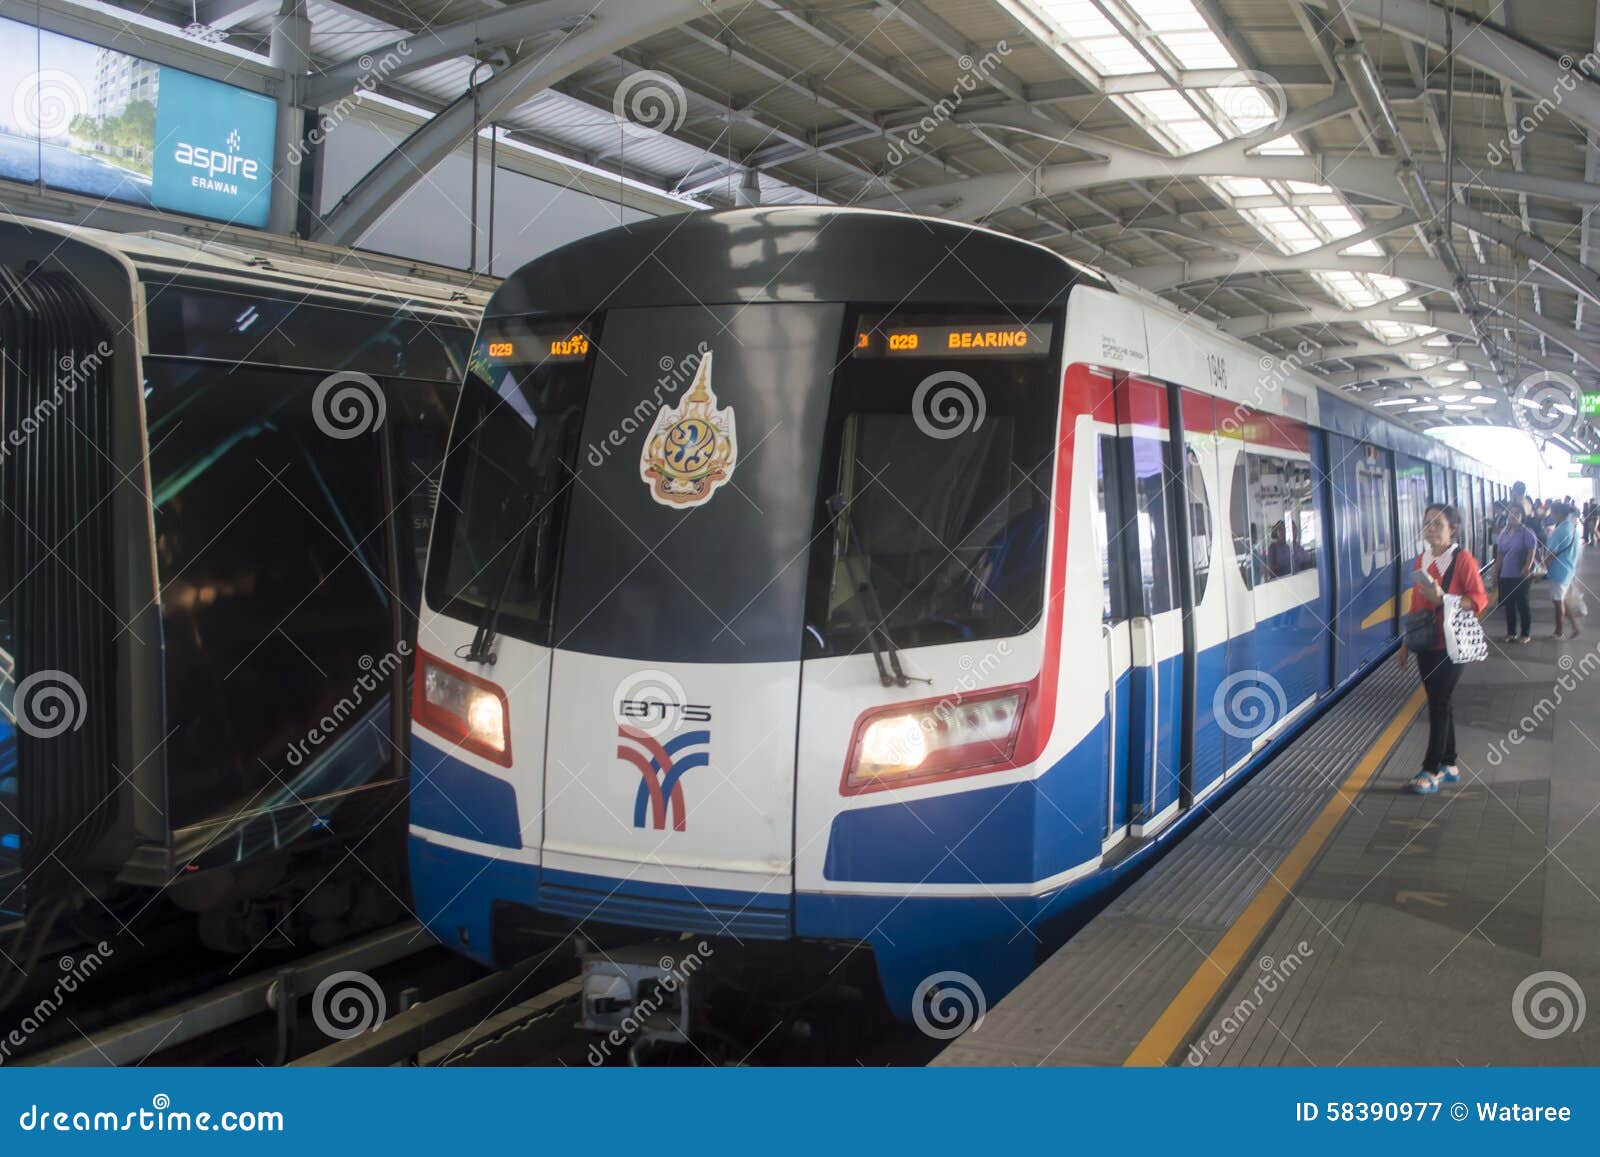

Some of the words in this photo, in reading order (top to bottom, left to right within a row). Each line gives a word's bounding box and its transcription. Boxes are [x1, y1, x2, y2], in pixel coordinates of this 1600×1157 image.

[174, 142, 258, 180] aspire
[191, 176, 238, 195] ERAWAN
[489, 343, 512, 356] 029
[889, 334, 918, 349] 029
[948, 332, 1027, 348] BEARING
[620, 700, 712, 722] BTS
